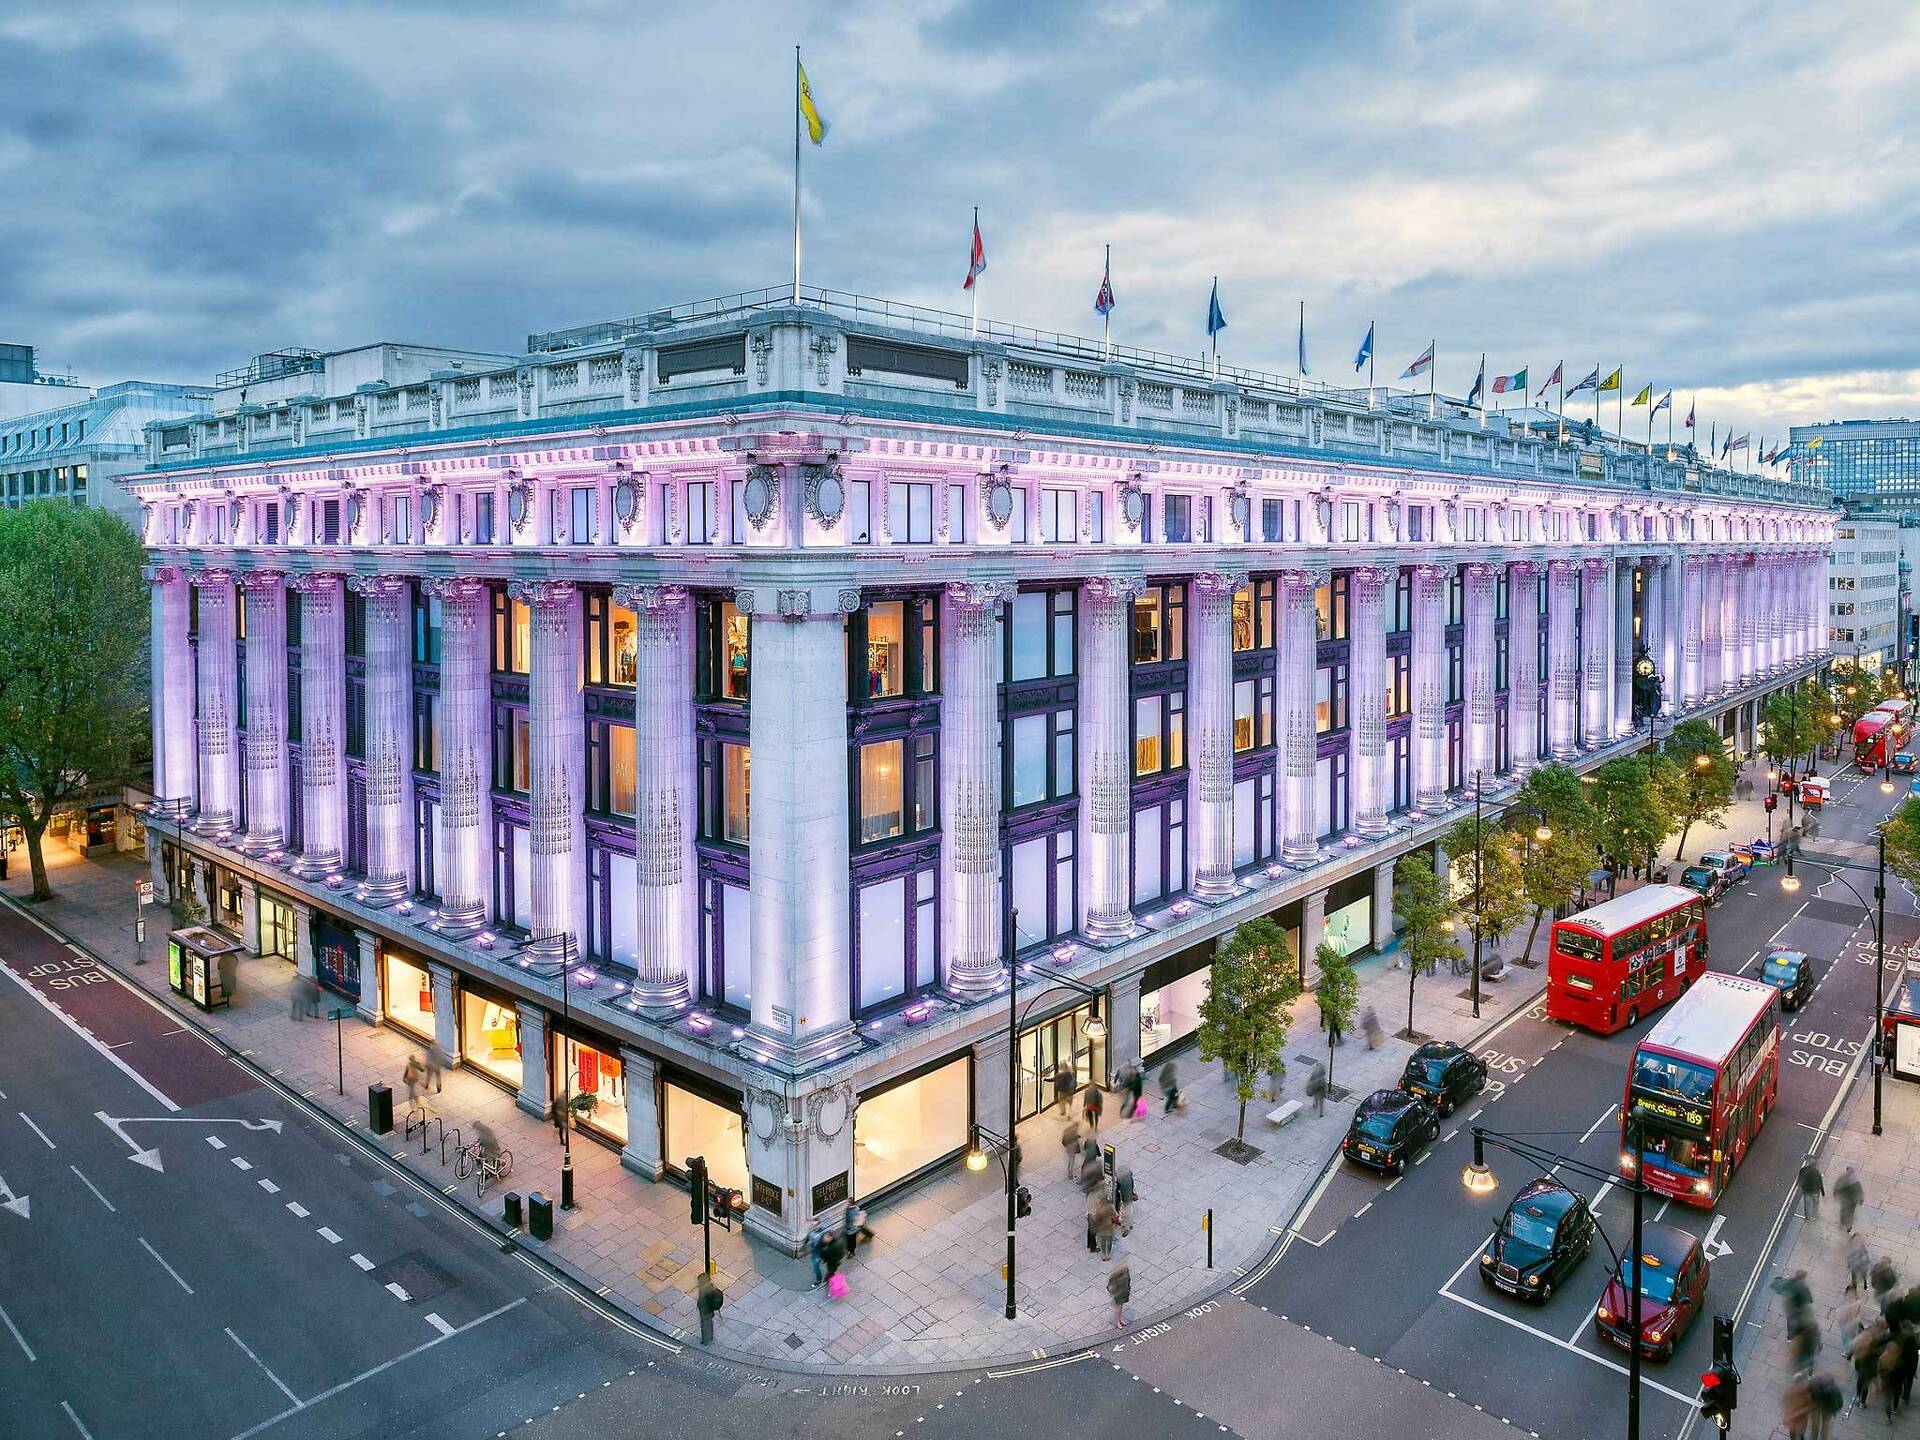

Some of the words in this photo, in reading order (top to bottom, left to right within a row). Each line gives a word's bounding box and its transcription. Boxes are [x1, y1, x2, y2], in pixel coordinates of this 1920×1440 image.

[28, 957, 96, 977] STOP
[49, 971, 108, 990] BUS
[1792, 1031, 1862, 1056] STOP
[1478, 1050, 1526, 1073] BUS
[1788, 1050, 1847, 1077] BUS
[1686, 1110, 1703, 1125] 189
[1185, 1300, 1221, 1320] LOOK
[1130, 1321, 1172, 1346] RIGHT
[818, 1385, 869, 1397] RIGHT
[882, 1384, 921, 1396] LOOK
